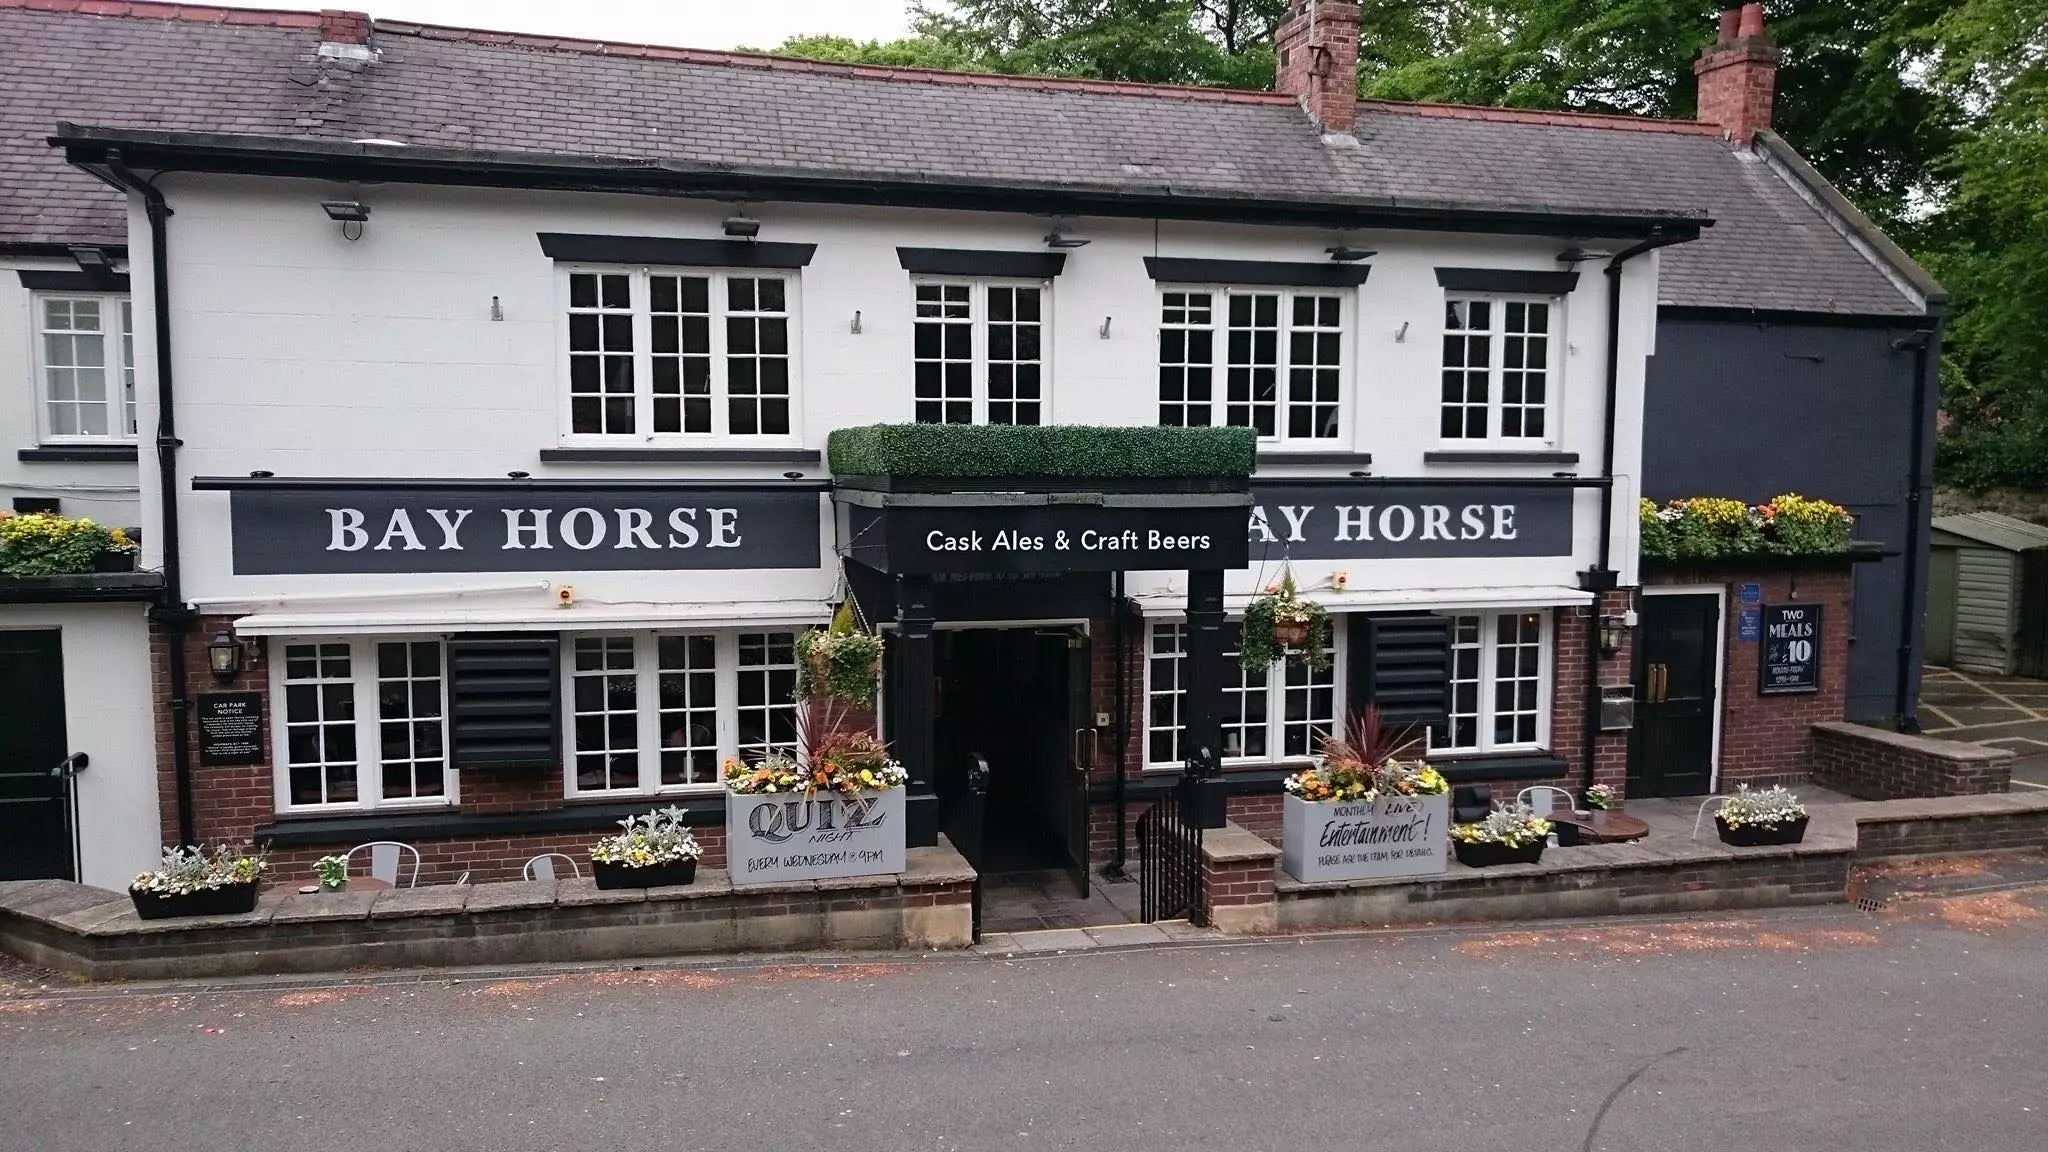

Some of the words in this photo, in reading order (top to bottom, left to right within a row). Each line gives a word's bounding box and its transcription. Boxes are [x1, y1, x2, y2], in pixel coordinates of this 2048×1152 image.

[325, 507, 473, 552] BAY
[500, 506, 743, 551] HORSE
[1247, 504, 1315, 543] AY
[1333, 504, 1518, 542] HORSE
[926, 530, 983, 551] Cask
[991, 530, 1045, 551] Ales
[1054, 529, 1070, 550] &
[1081, 529, 1138, 550] Craft
[1147, 529, 1211, 550] Beers
[1782, 610, 1804, 620] TWO
[1769, 623, 1813, 637] MEALS
[748, 797, 886, 842] QUIZ
[1333, 805, 1375, 817] MONTHLY
[808, 831, 857, 844] NIGHT
[747, 856, 779, 873] EVERY
[784, 851, 847, 868] WEDNESDAY
[858, 849, 884, 863] 9PM
